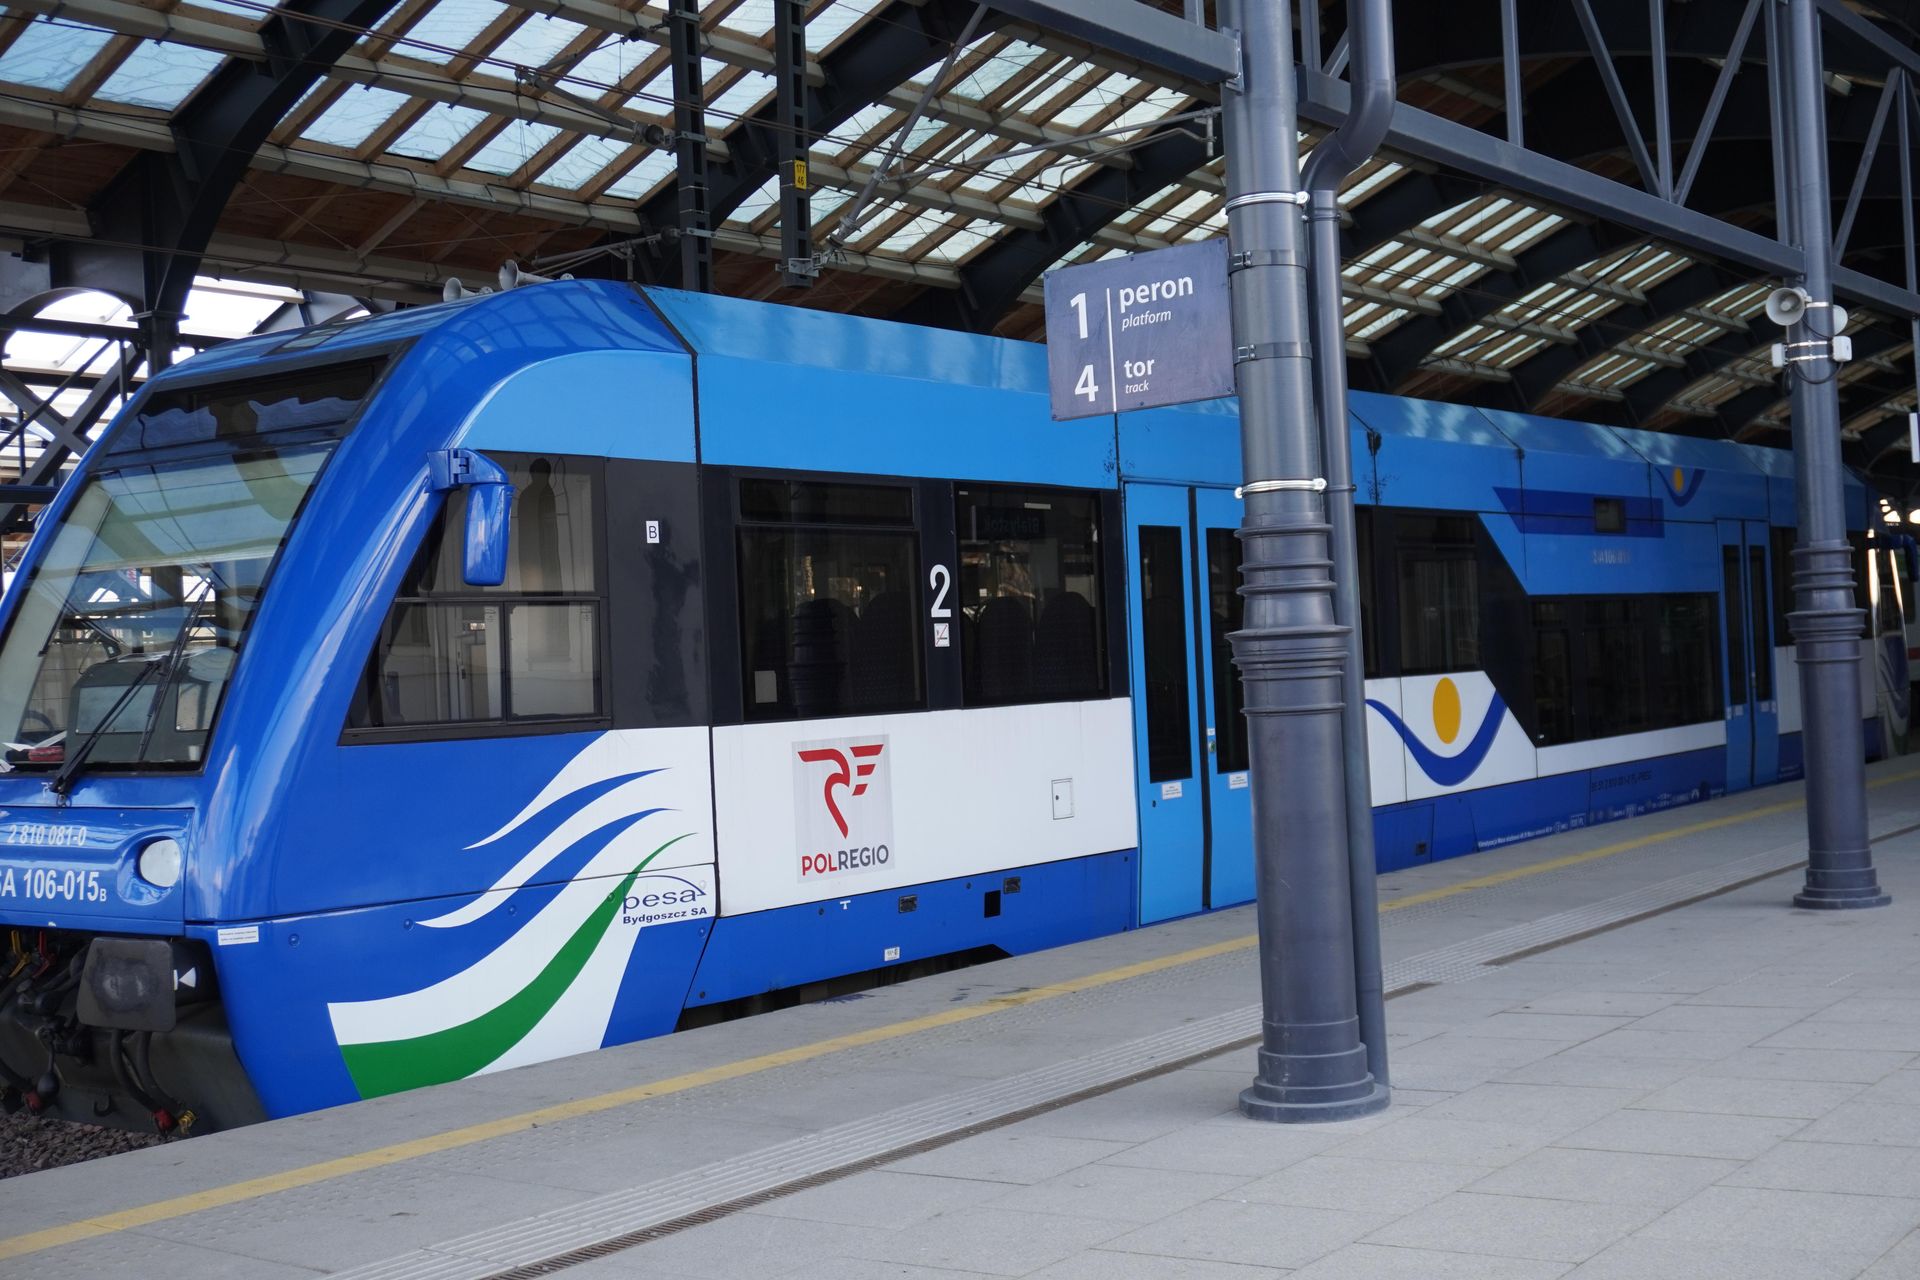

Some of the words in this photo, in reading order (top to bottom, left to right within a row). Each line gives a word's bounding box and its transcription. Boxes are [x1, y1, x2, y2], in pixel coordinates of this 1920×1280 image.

[1070, 292, 1088, 339] 1
[1119, 276, 1193, 313] peron
[1121, 310, 1172, 331] platform
[1074, 364, 1099, 402] 4
[1124, 359, 1155, 379] tor
[1125, 380, 1149, 394] track
[929, 564, 952, 618] 2
[7, 824, 17, 844] 2
[20, 825, 46, 845] 810
[48, 825, 87, 846] 081-0
[801, 844, 890, 877] POLREGIO
[0, 868, 17, 898] A
[623, 888, 697, 915] pesa
[623, 910, 687, 926] Bydgoszcz
[691, 906, 708, 916] SA
